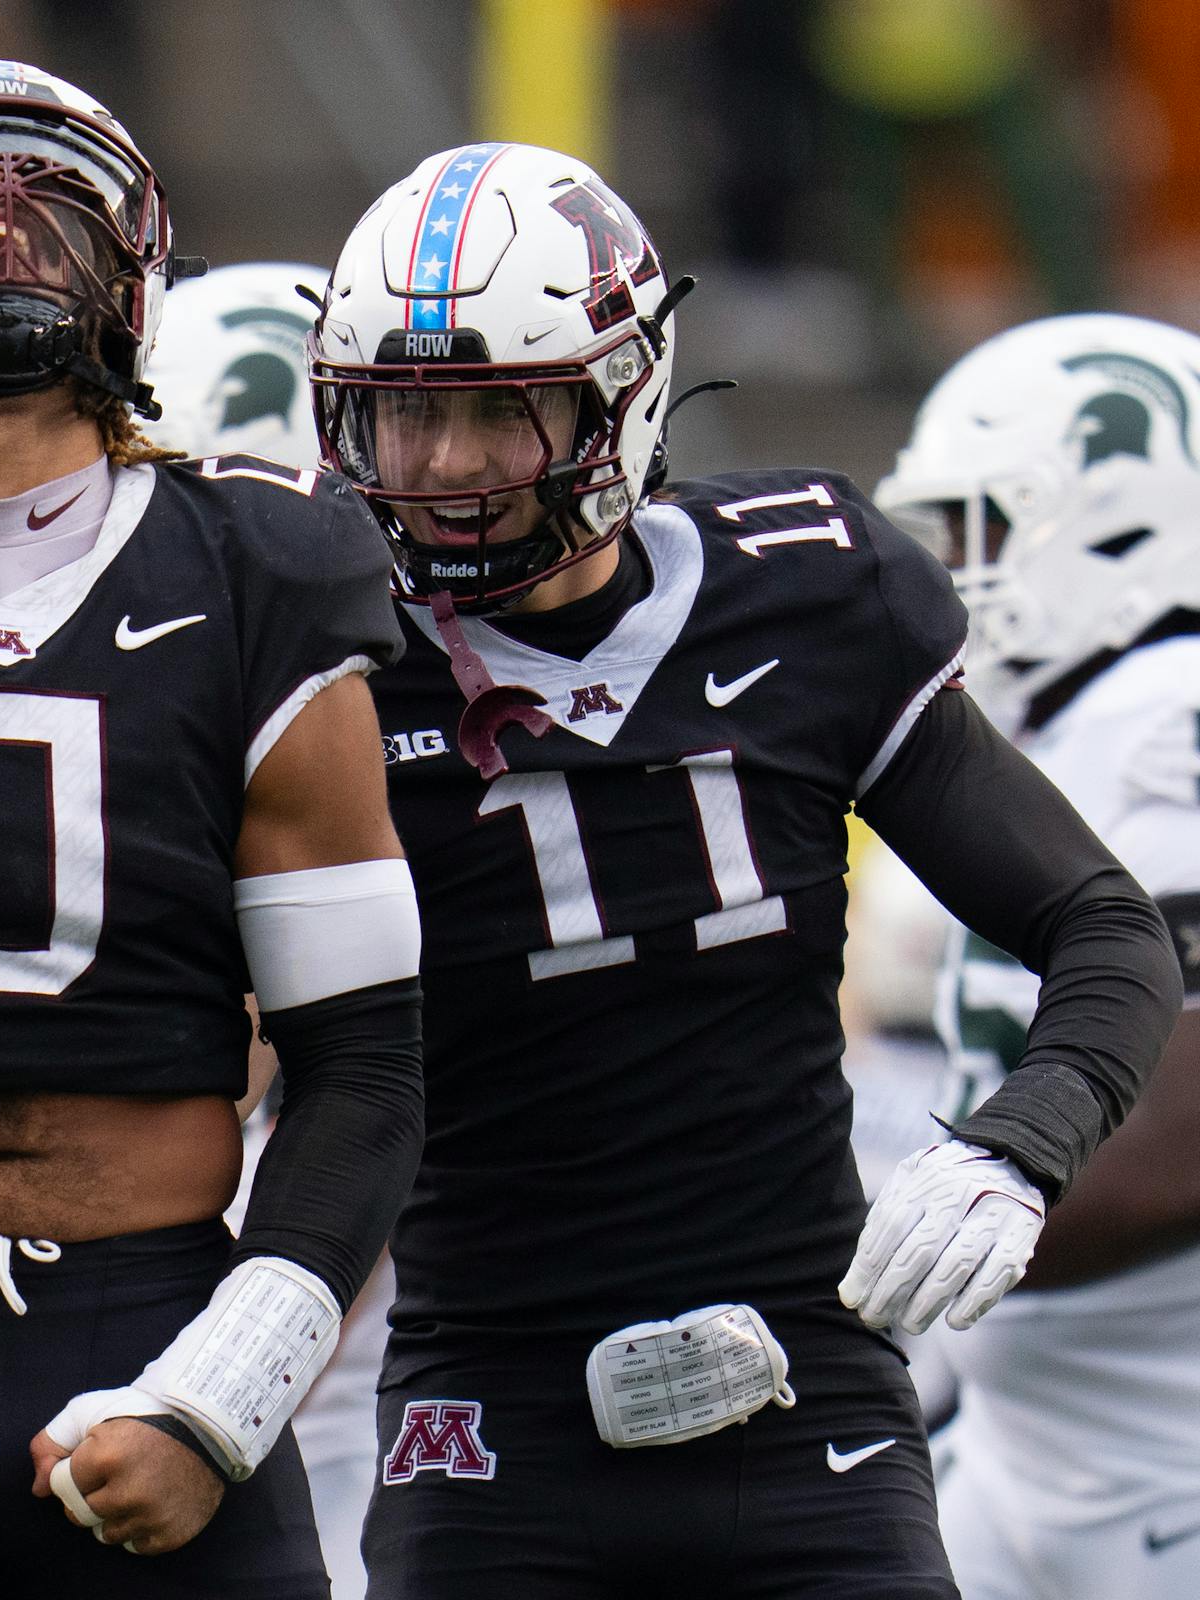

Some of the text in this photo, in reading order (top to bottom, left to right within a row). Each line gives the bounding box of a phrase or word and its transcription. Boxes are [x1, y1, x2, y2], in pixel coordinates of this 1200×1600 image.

[405, 333, 454, 358] ROW
[713, 482, 856, 559] 11
[431, 562, 490, 578] Riddel
[565, 682, 626, 724] M
[476, 746, 793, 983] 11
[622, 1359, 646, 1367] JORDAN
[682, 1362, 704, 1372] CHOICE
[621, 1374, 653, 1384] HIGH SLAM
[681, 1376, 711, 1389] NUB YOYO
[631, 1392, 651, 1400] VIKING
[690, 1393, 709, 1403] FROST
[631, 1407, 658, 1416] CHICAGO
[692, 1409, 713, 1419] DECIDE
[629, 1421, 666, 1433] BLUFF SLAM
[384, 1401, 495, 1484] M
